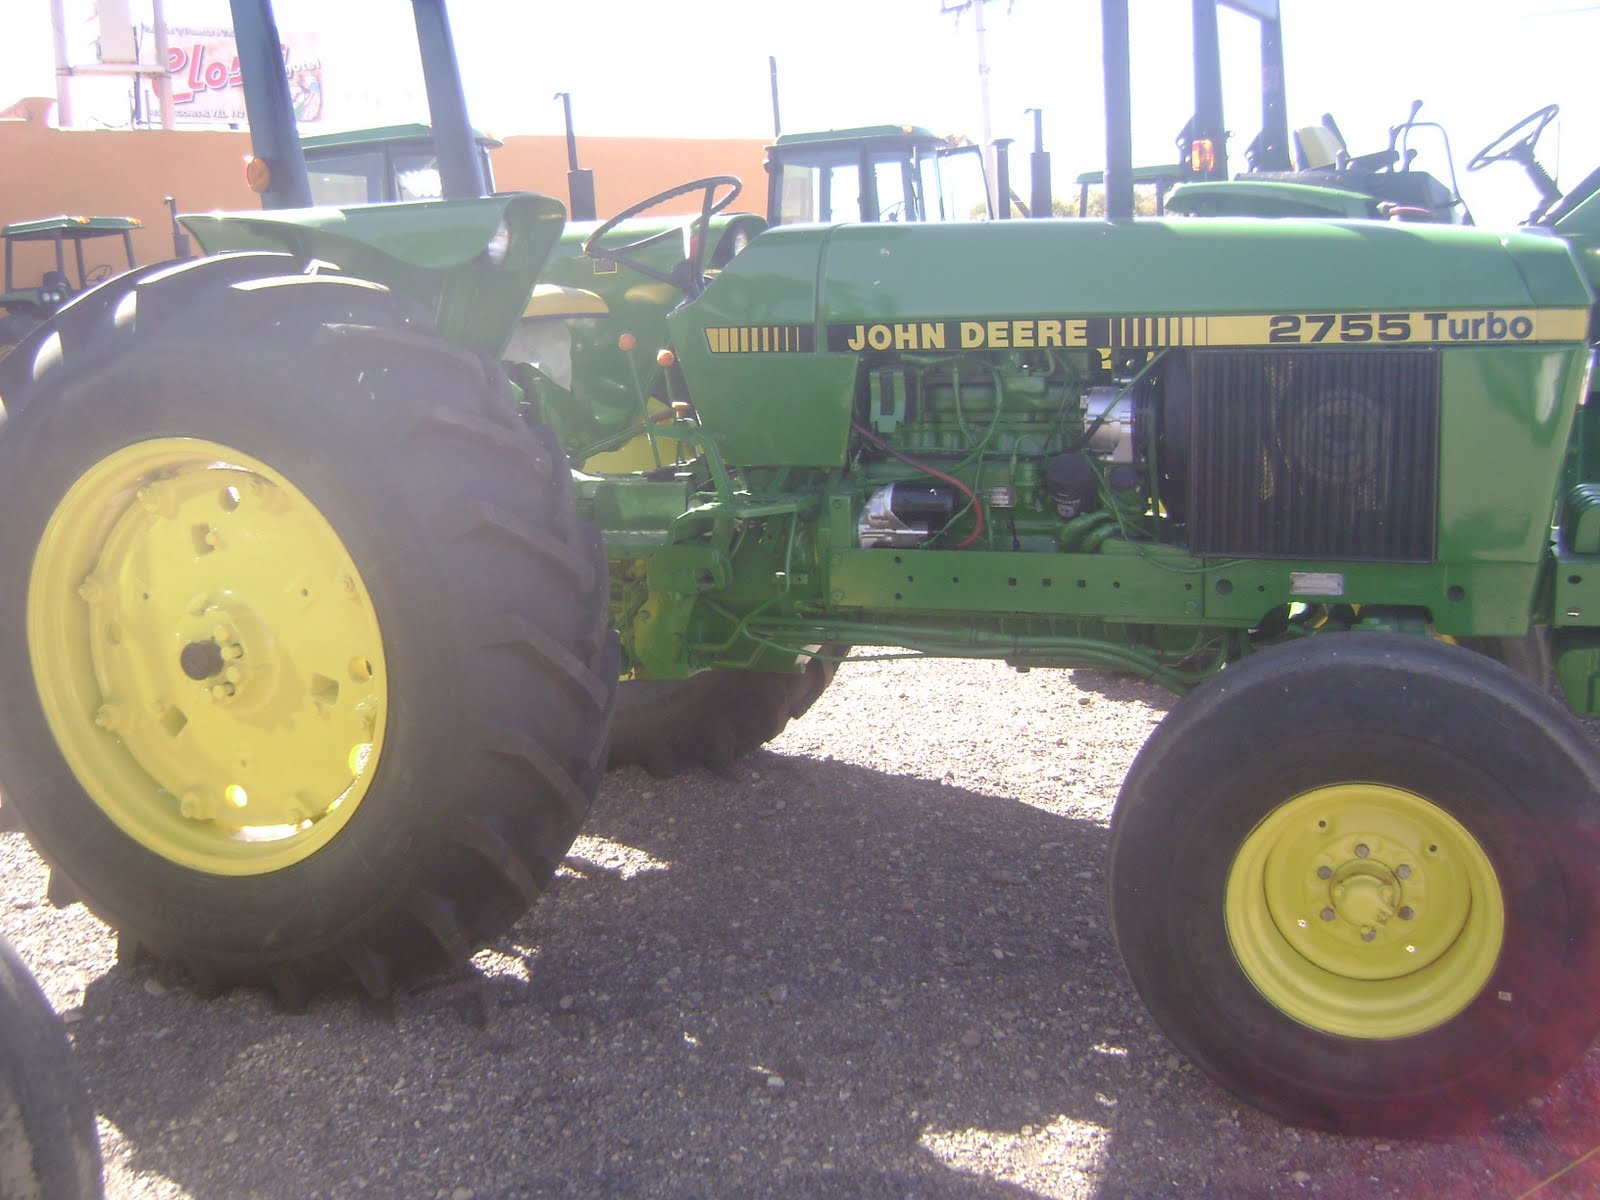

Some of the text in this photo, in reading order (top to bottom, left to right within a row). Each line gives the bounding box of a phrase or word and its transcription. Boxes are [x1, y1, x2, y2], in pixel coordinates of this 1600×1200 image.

[848, 319, 1088, 351] JOHN DEERE
[1269, 312, 1534, 344] 2755 Turbo
